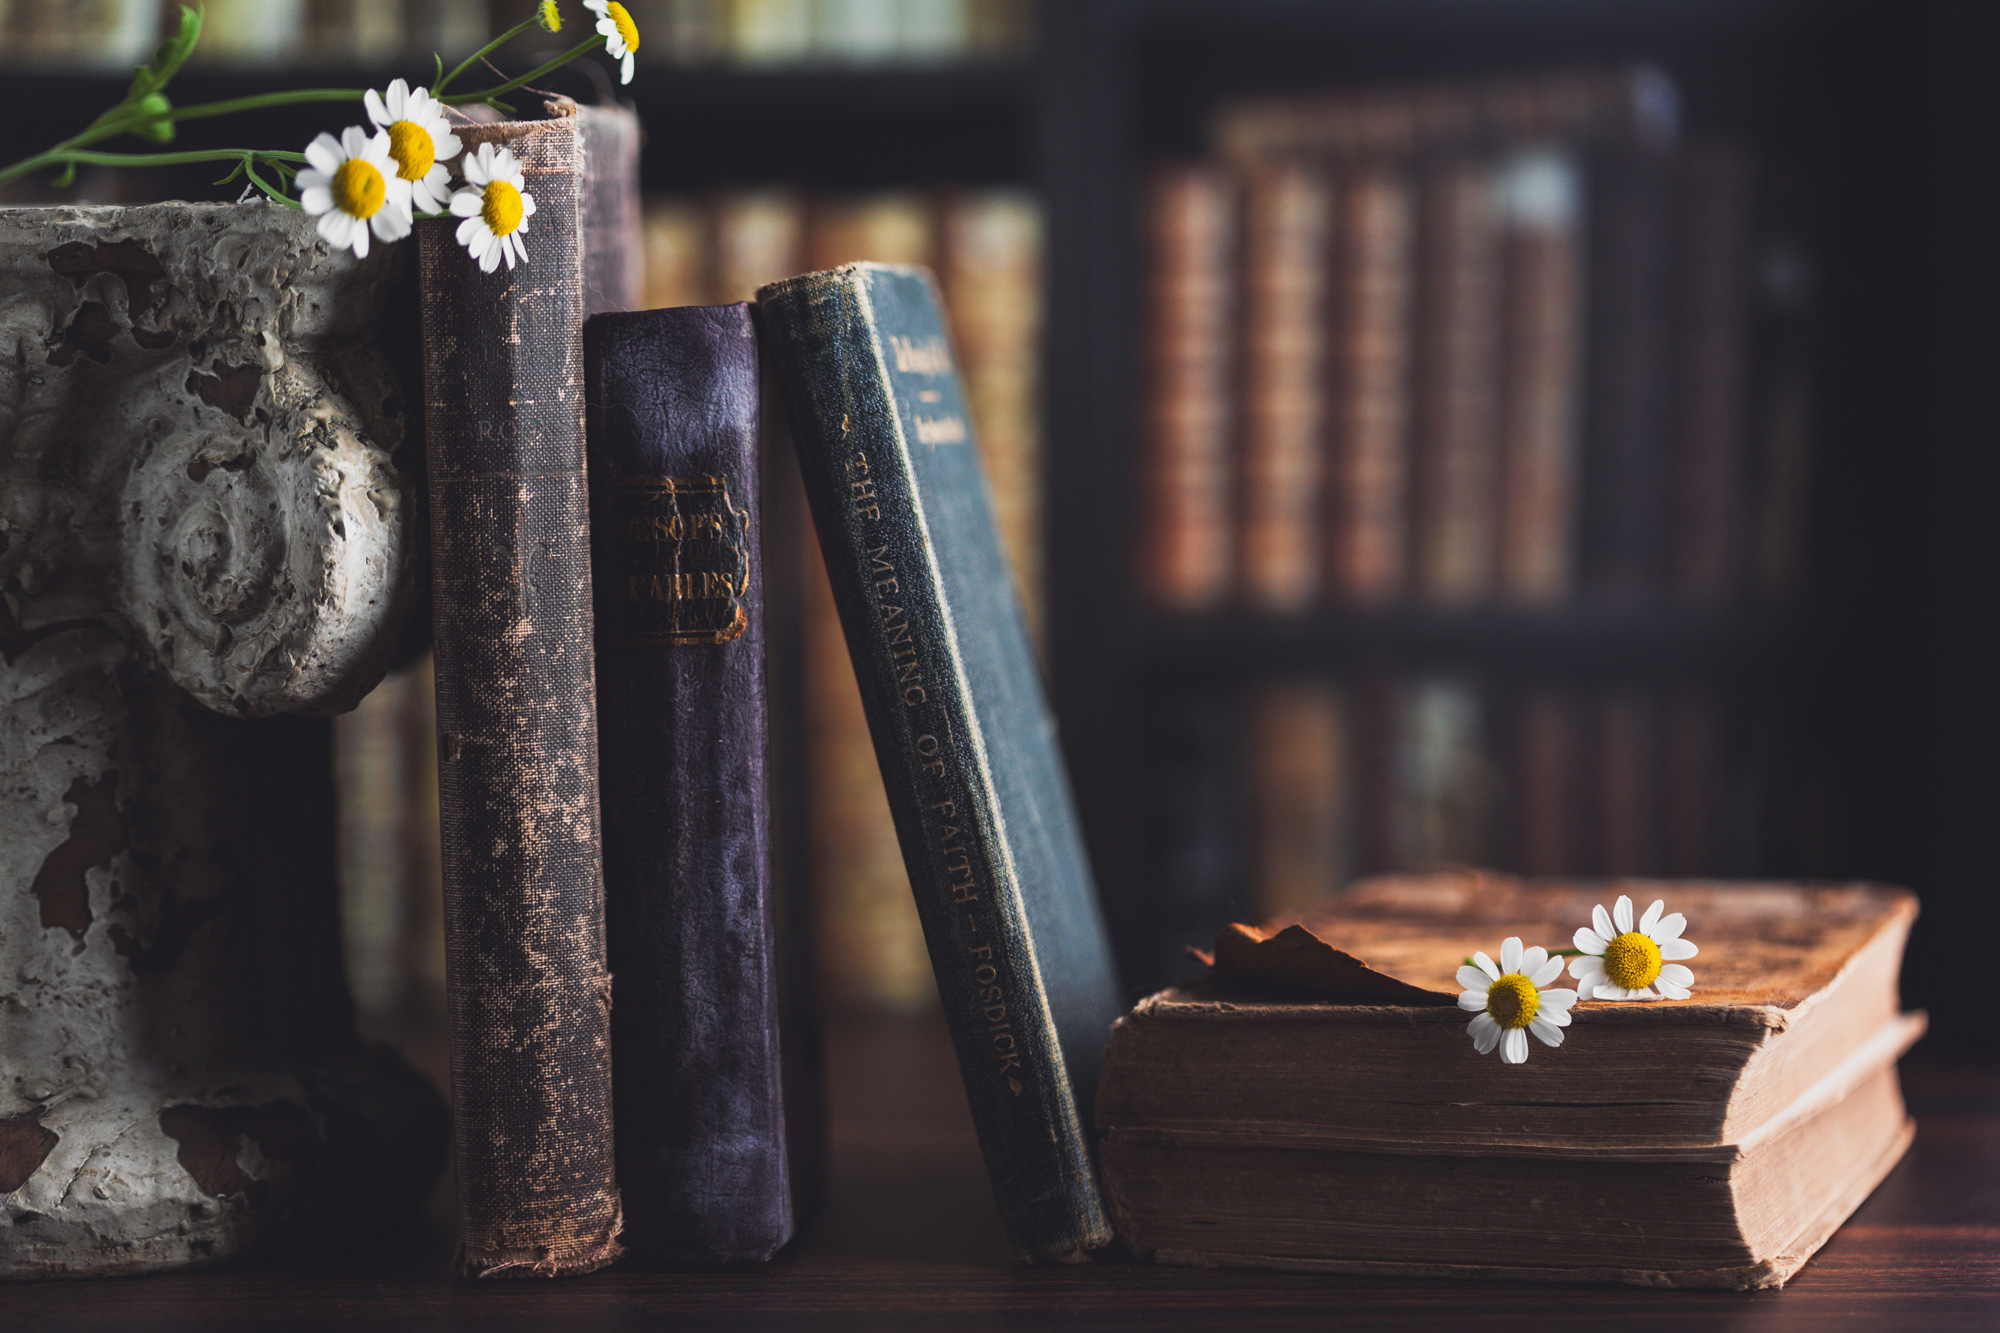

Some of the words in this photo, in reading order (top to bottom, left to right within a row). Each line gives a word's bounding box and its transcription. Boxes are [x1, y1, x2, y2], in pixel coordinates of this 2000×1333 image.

[846, 452, 881, 524] THE
[867, 544, 927, 707] MEANING
[917, 733, 946, 780] OF
[931, 797, 979, 904] FAITH
[968, 943, 1022, 1075] FOSDICK
